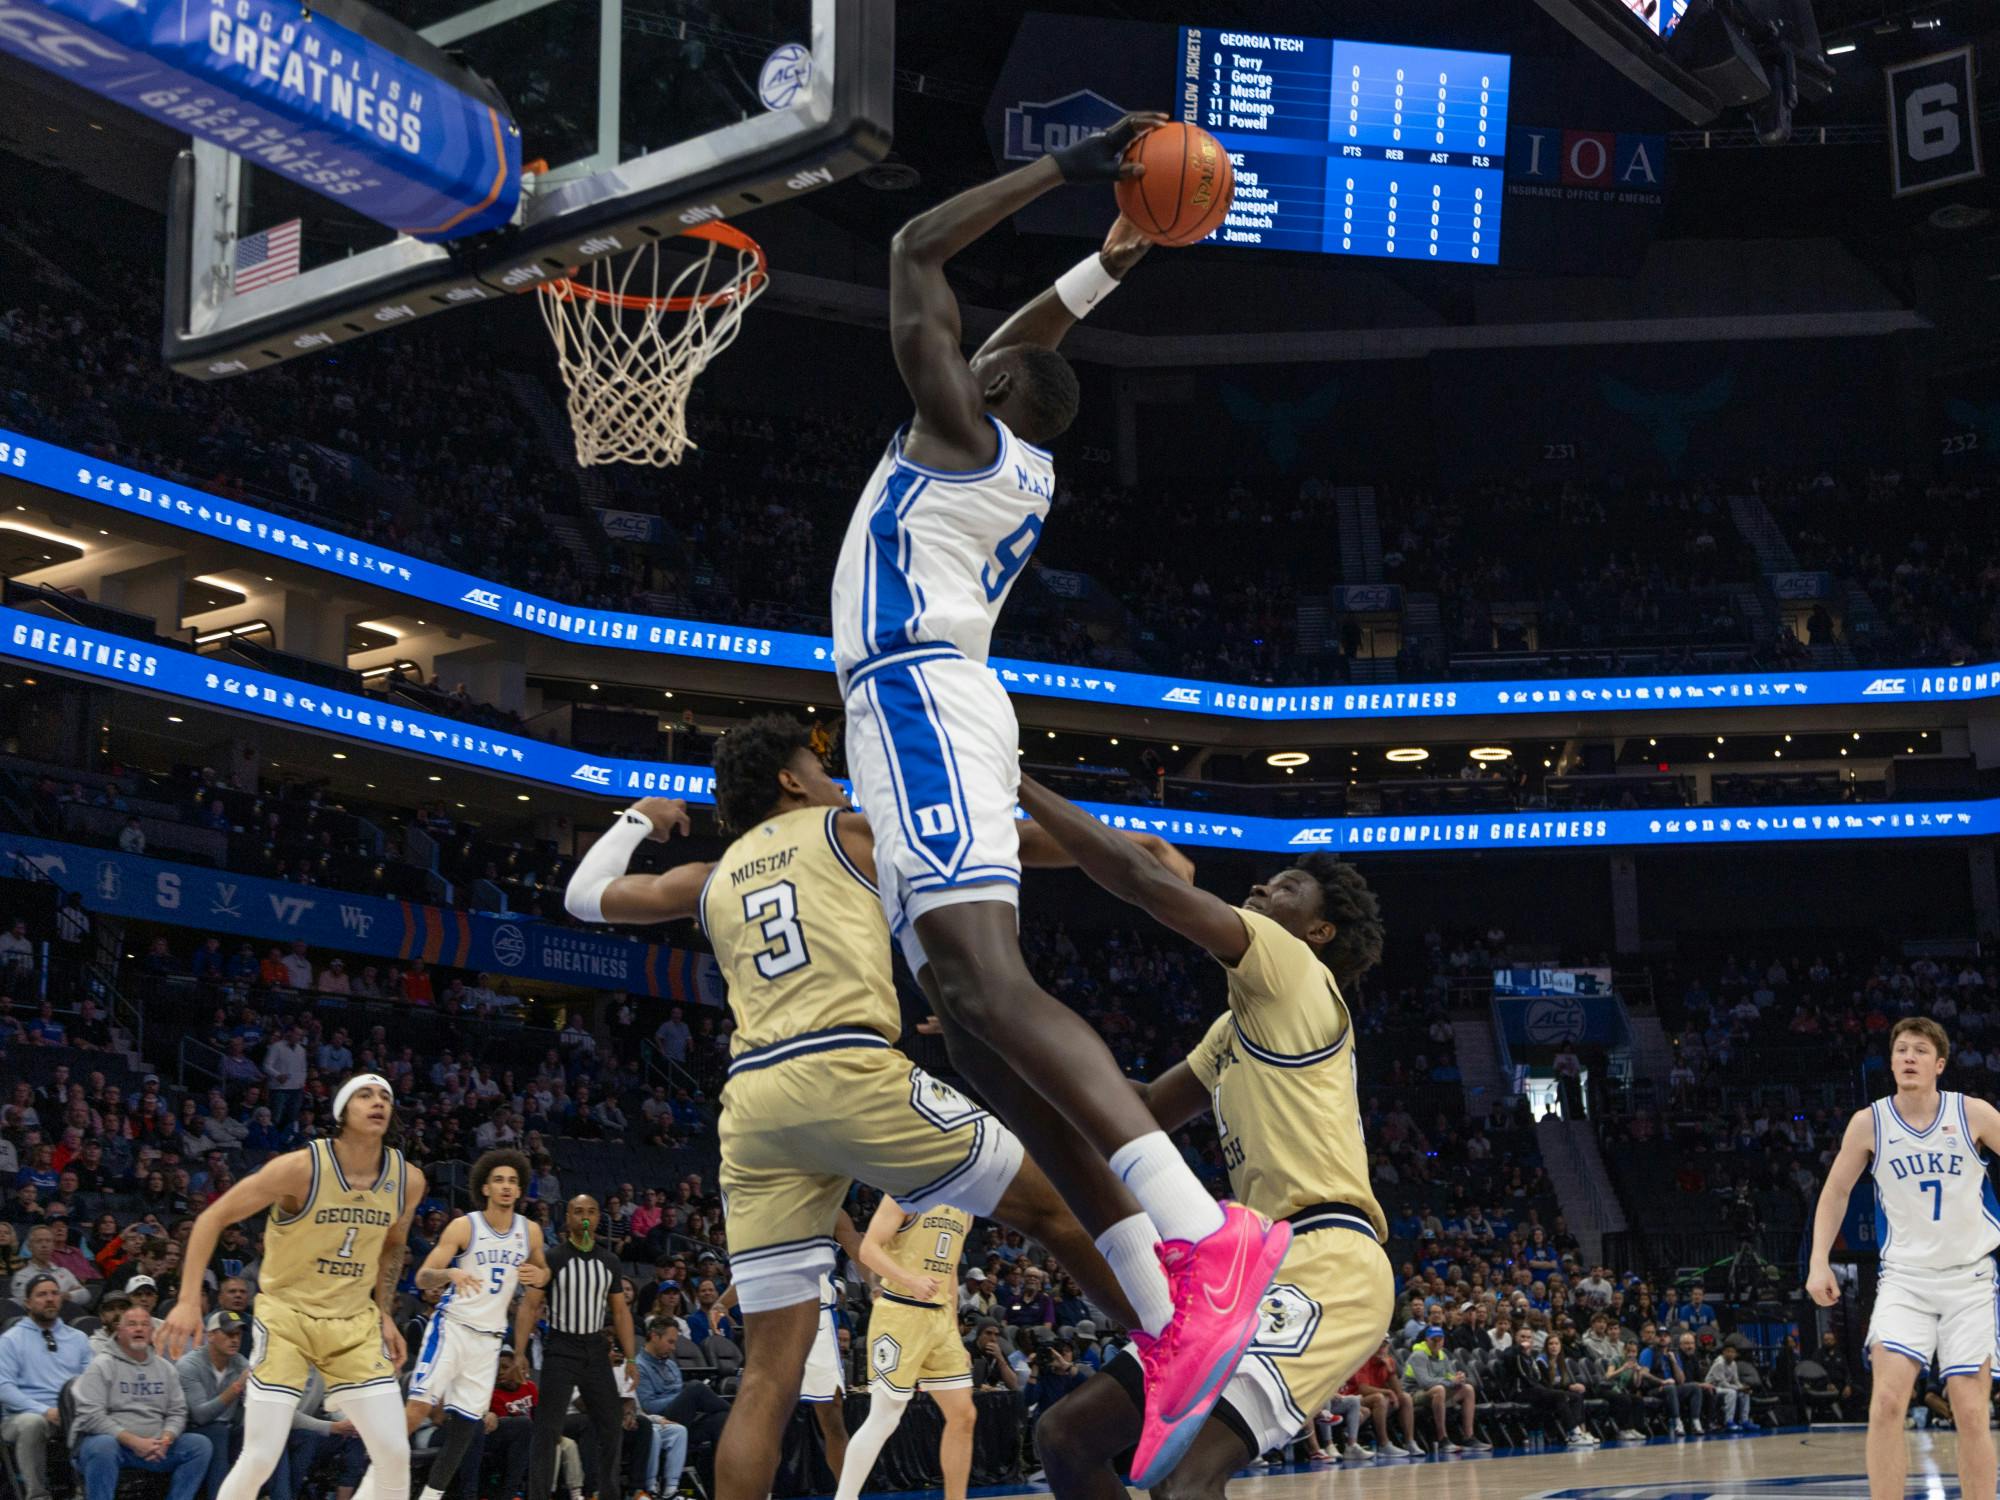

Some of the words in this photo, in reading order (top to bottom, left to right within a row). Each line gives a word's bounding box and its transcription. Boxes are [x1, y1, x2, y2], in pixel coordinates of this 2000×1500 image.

[1186, 29, 1201, 80] JACKETS
[1220, 33, 1271, 49] GEORGIA
[1273, 37, 1304, 52] TECH
[209, 10, 421, 154] GREATNESS
[1213, 53, 1222, 65] 0
[1232, 54, 1262, 72] Terry
[1353, 65, 1360, 78] 0
[1397, 69, 1403, 82] 0
[1440, 72, 1447, 85] 0
[1482, 76, 1489, 89] 0
[1212, 84, 1220, 95] 3
[1230, 84, 1272, 100] Mustaf
[1351, 95, 1358, 107] 0
[1395, 98, 1402, 111] 0
[1438, 102, 1445, 114] 0
[1480, 105, 1487, 118] 0
[1214, 69, 1221, 80] 1
[1231, 70, 1273, 86] George
[1352, 80, 1359, 93] 0
[1396, 84, 1403, 96] 0
[1439, 88, 1446, 100] 0
[1481, 91, 1488, 104] 0
[1208, 113, 1222, 126] 31
[1229, 114, 1268, 130] Powell
[1350, 125, 1357, 137] 0
[1394, 128, 1400, 141] 0
[1436, 132, 1443, 144] 0
[1479, 135, 1485, 147] 0
[1209, 98, 1222, 110] 11
[1230, 99, 1274, 116] Ndongo
[1350, 109, 1357, 121] 0
[1394, 112, 1401, 125] 0
[1437, 116, 1444, 129] 0
[1479, 119, 1486, 132] 0
[1904, 82, 1961, 162] 6
[139, 90, 363, 195] GREATNESS
[1343, 146, 1362, 157] PTS
[1385, 149, 1404, 160] REB
[1430, 153, 1449, 164] AST
[1472, 156, 1489, 167] FLS
[1227, 153, 1245, 166] KE
[1233, 169, 1258, 185] lagg
[1346, 178, 1354, 190] 0
[1390, 181, 1398, 194] 0
[1433, 184, 1440, 197] 0
[1475, 187, 1482, 200] 0
[1508, 184, 1562, 198] INSURANCE
[1567, 188, 1599, 201] OFFICE
[1604, 191, 1616, 201] OF
[1620, 193, 1662, 204] AMERICA
[1234, 188, 1269, 199] roctor
[1345, 193, 1353, 205] 0
[1389, 196, 1397, 209] 0
[1432, 199, 1439, 212] 0
[1474, 202, 1482, 215] 0
[1225, 214, 1273, 228] Maluach
[1344, 222, 1351, 234] 0
[1388, 225, 1395, 237] 0
[1430, 228, 1438, 241] 0
[1472, 231, 1480, 244] 0
[1344, 207, 1352, 219] 0
[1388, 210, 1396, 223] 0
[1431, 213, 1439, 226] 0
[1473, 216, 1481, 229] 0
[1224, 229, 1261, 243] James
[1343, 237, 1350, 250] 0
[1387, 240, 1394, 253] 0
[1430, 243, 1437, 256] 0
[1472, 246, 1479, 259] 0
[1543, 444, 1575, 460] 231
[1941, 433, 1979, 456] 232
[981, 513, 1045, 603] 9
[461, 588, 502, 608] ACC
[513, 601, 638, 640] ACCOMPLISH
[649, 627, 772, 656] GREATNESS
[13, 624, 158, 676] GREATNESS
[1862, 679, 1906, 694] ACC
[1921, 672, 2000, 693] ACCOMP
[1162, 687, 1202, 704] ACC
[1214, 692, 1334, 711] ACCOMPLISH
[1344, 692, 1457, 710] GREATNESS
[571, 764, 613, 785] ACC
[628, 771, 716, 794] ACCOMP
[915, 803, 956, 836] D
[1288, 828, 1334, 844] ACC
[1349, 825, 1479, 844] ACCOMPLISH
[1490, 820, 1607, 839] GREATNESS
[730, 847, 798, 888] MUSTAF
[742, 879, 811, 980] 3
[542, 950, 628, 979] GREATNESS
[1534, 1010, 1581, 1026] ACC
[1223, 1137, 1245, 1171] CH
[1889, 1152, 1963, 1180] DUKE
[1919, 1179, 1942, 1221] 7
[315, 1207, 391, 1226] GEORGIA
[336, 1227, 360, 1258] 1
[935, 1232, 952, 1259] 0
[317, 1258, 366, 1277] TECH
[475, 1249, 525, 1267] DUKE
[924, 1259, 953, 1273] TECH
[489, 1268, 505, 1294] 5
[119, 1381, 165, 1395] DUKE
